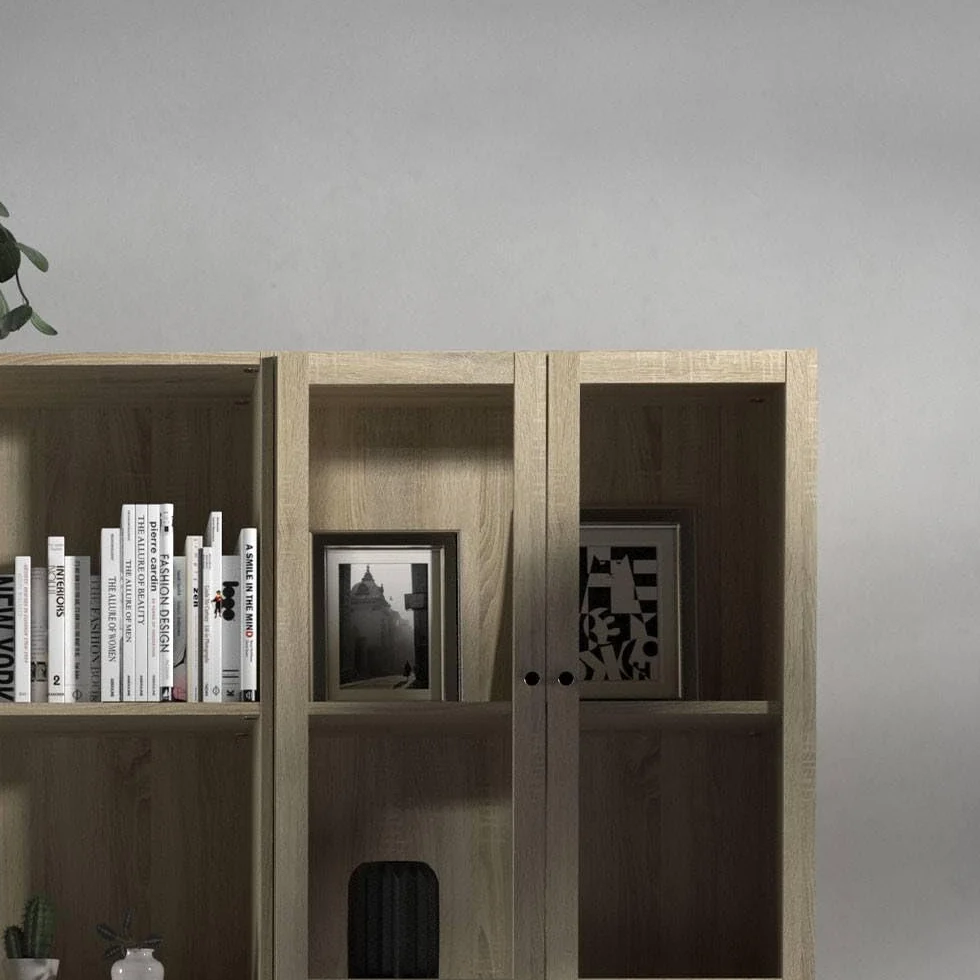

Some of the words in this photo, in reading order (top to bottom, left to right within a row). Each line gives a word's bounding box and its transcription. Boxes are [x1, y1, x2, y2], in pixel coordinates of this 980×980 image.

[137, 516, 145, 534] THE
[149, 521, 159, 553] pierre
[137, 536, 145, 572] ALLURE
[108, 578, 116, 589] THE
[137, 574, 145, 586] OF
[151, 557, 159, 592] cardin
[160, 554, 169, 605] FASHION
[246, 583, 253, 592] IN
[56, 566, 64, 618] INTERIORS
[90, 579, 100, 605] THE
[108, 592, 116, 622] ALLURE
[137, 588, 145, 625] BEAUTY
[125, 612, 132, 622] OF
[160, 610, 169, 653] DESIGN
[90, 607, 101, 663] FASHION
[108, 633, 116, 662] WOMEN
[53, 675, 61, 686] 2
